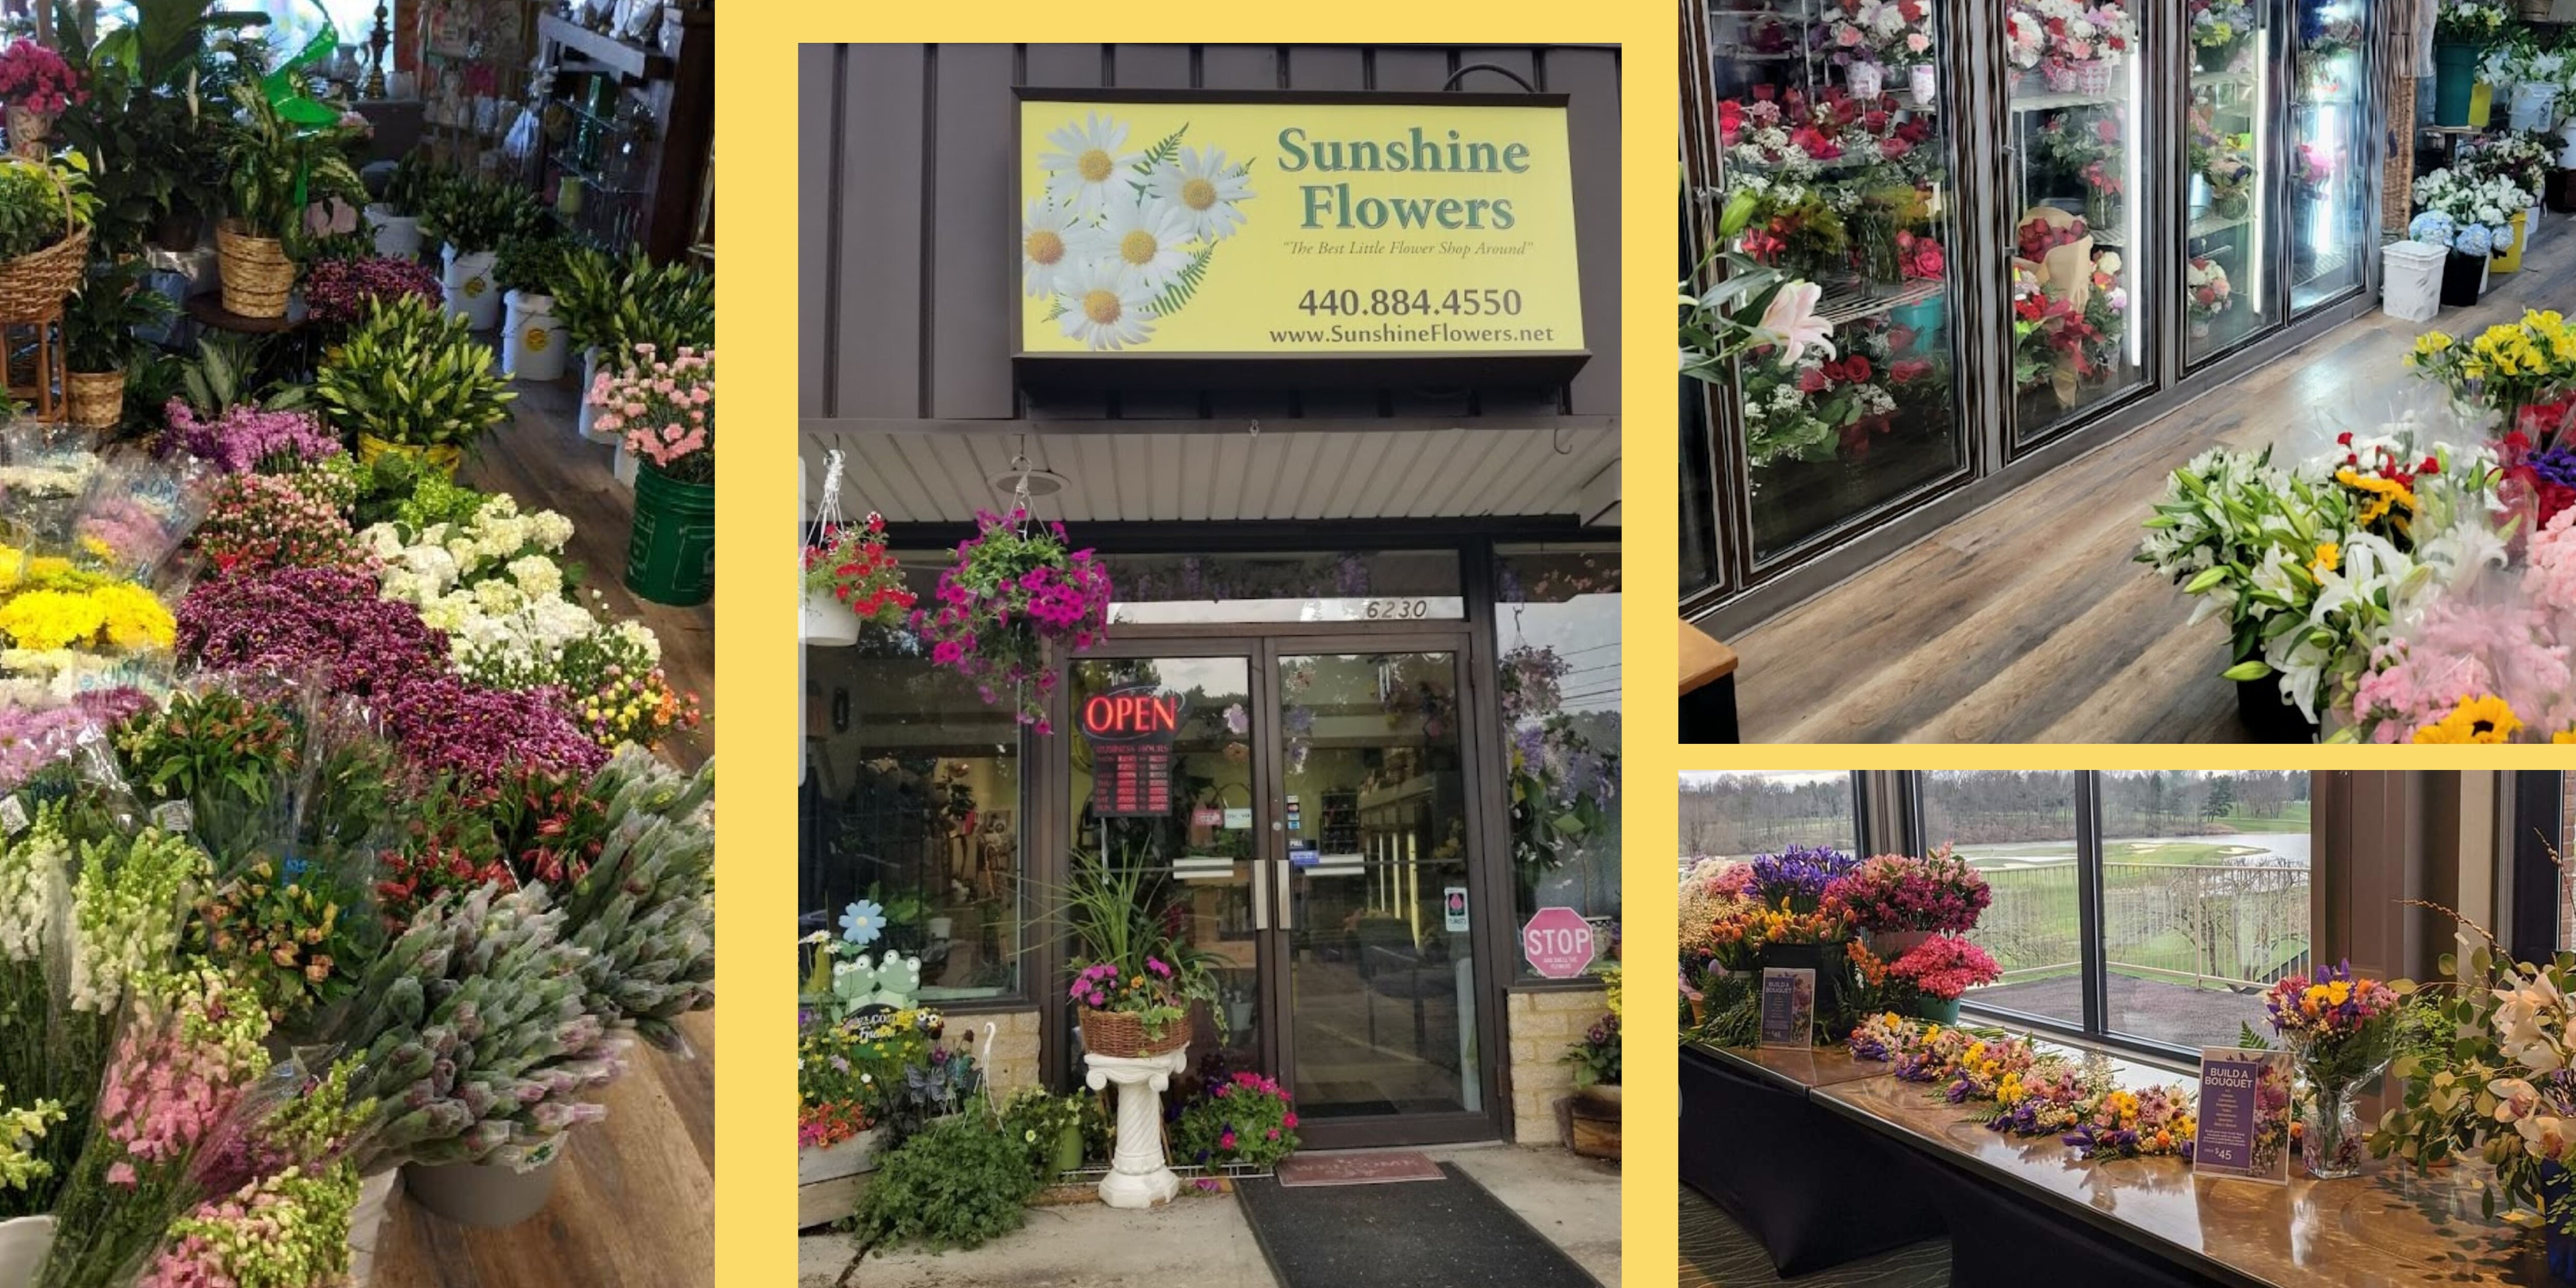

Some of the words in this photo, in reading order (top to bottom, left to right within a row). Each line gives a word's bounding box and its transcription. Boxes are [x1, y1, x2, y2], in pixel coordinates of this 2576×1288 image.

[1278, 126, 1530, 174] Sunshine
[1299, 182, 1516, 230] Flowers
[1318, 242, 1344, 255] Best
[1349, 241, 1385, 255] Little
[1390, 241, 1435, 255] Flower
[1439, 241, 1471, 259] Shop
[1298, 289, 1522, 316] 440.884.4550
[1269, 323, 1554, 343] www.SunshineFlowers.net
[1367, 600, 1427, 618] 6230
[1086, 697, 1176, 731] OPEN
[1528, 928, 1589, 956] STOP
[2205, 1077, 2253, 1088] BOUQUET
[2211, 1067, 2240, 1078] BUILD
[2242, 1070, 2248, 1078] A
[2215, 1147, 2232, 1160] $45
